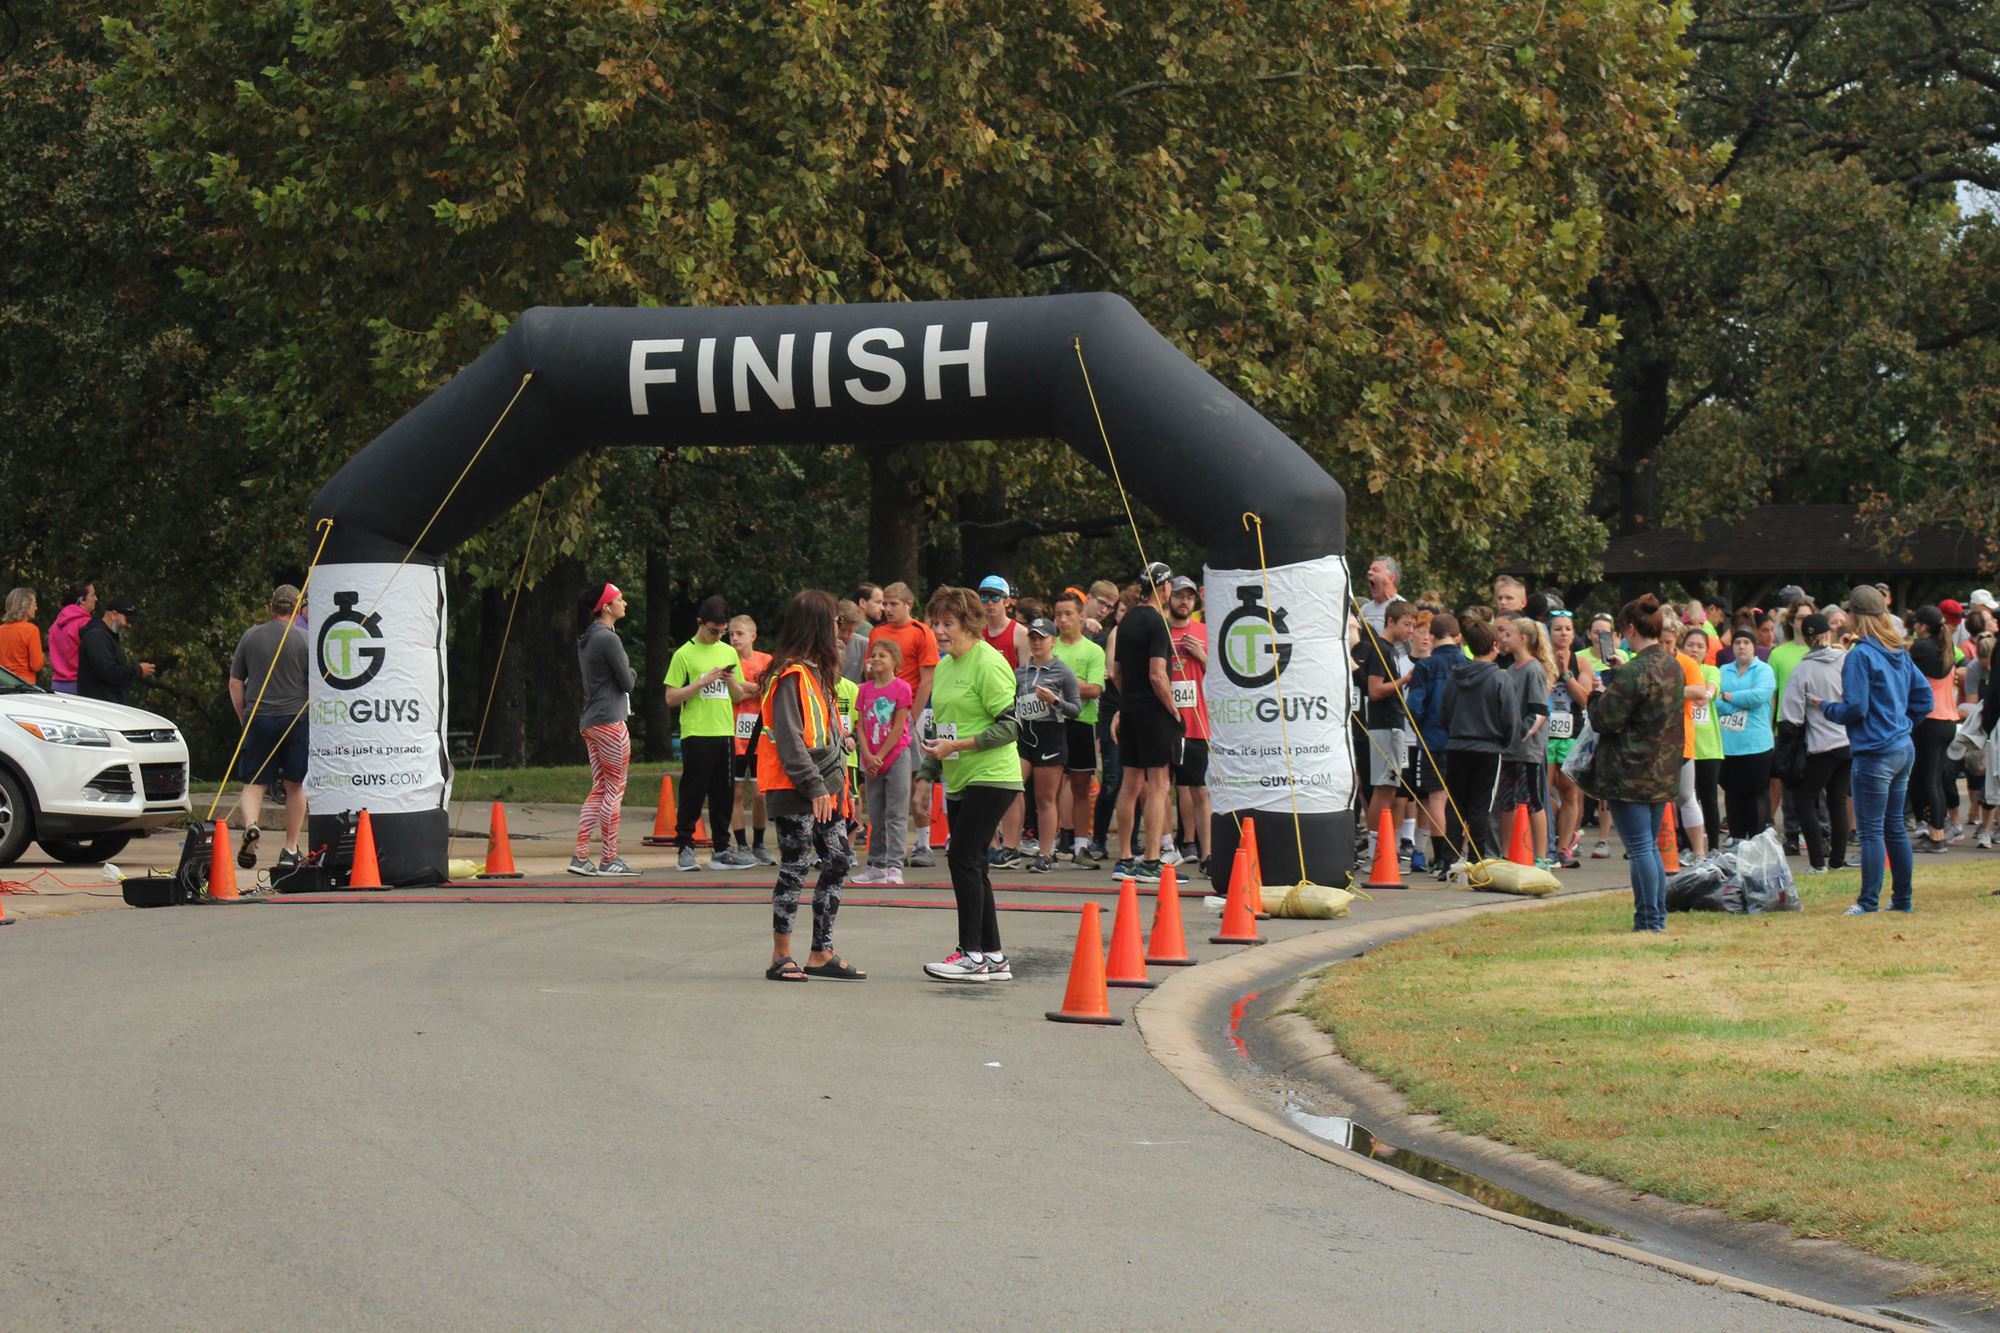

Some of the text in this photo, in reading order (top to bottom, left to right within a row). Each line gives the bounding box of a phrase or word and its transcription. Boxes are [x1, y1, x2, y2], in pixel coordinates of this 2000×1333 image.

[629, 321, 989, 415] FINISH
[1171, 689, 1195, 703] 844
[1022, 701, 1046, 716] 3900
[335, 746, 350, 756] it's
[352, 746, 373, 757] just
[376, 747, 383, 755] a
[386, 744, 424, 756] parade.
[1242, 745, 1257, 756] it's
[1260, 747, 1282, 758] just
[1295, 744, 1333, 757] parade.
